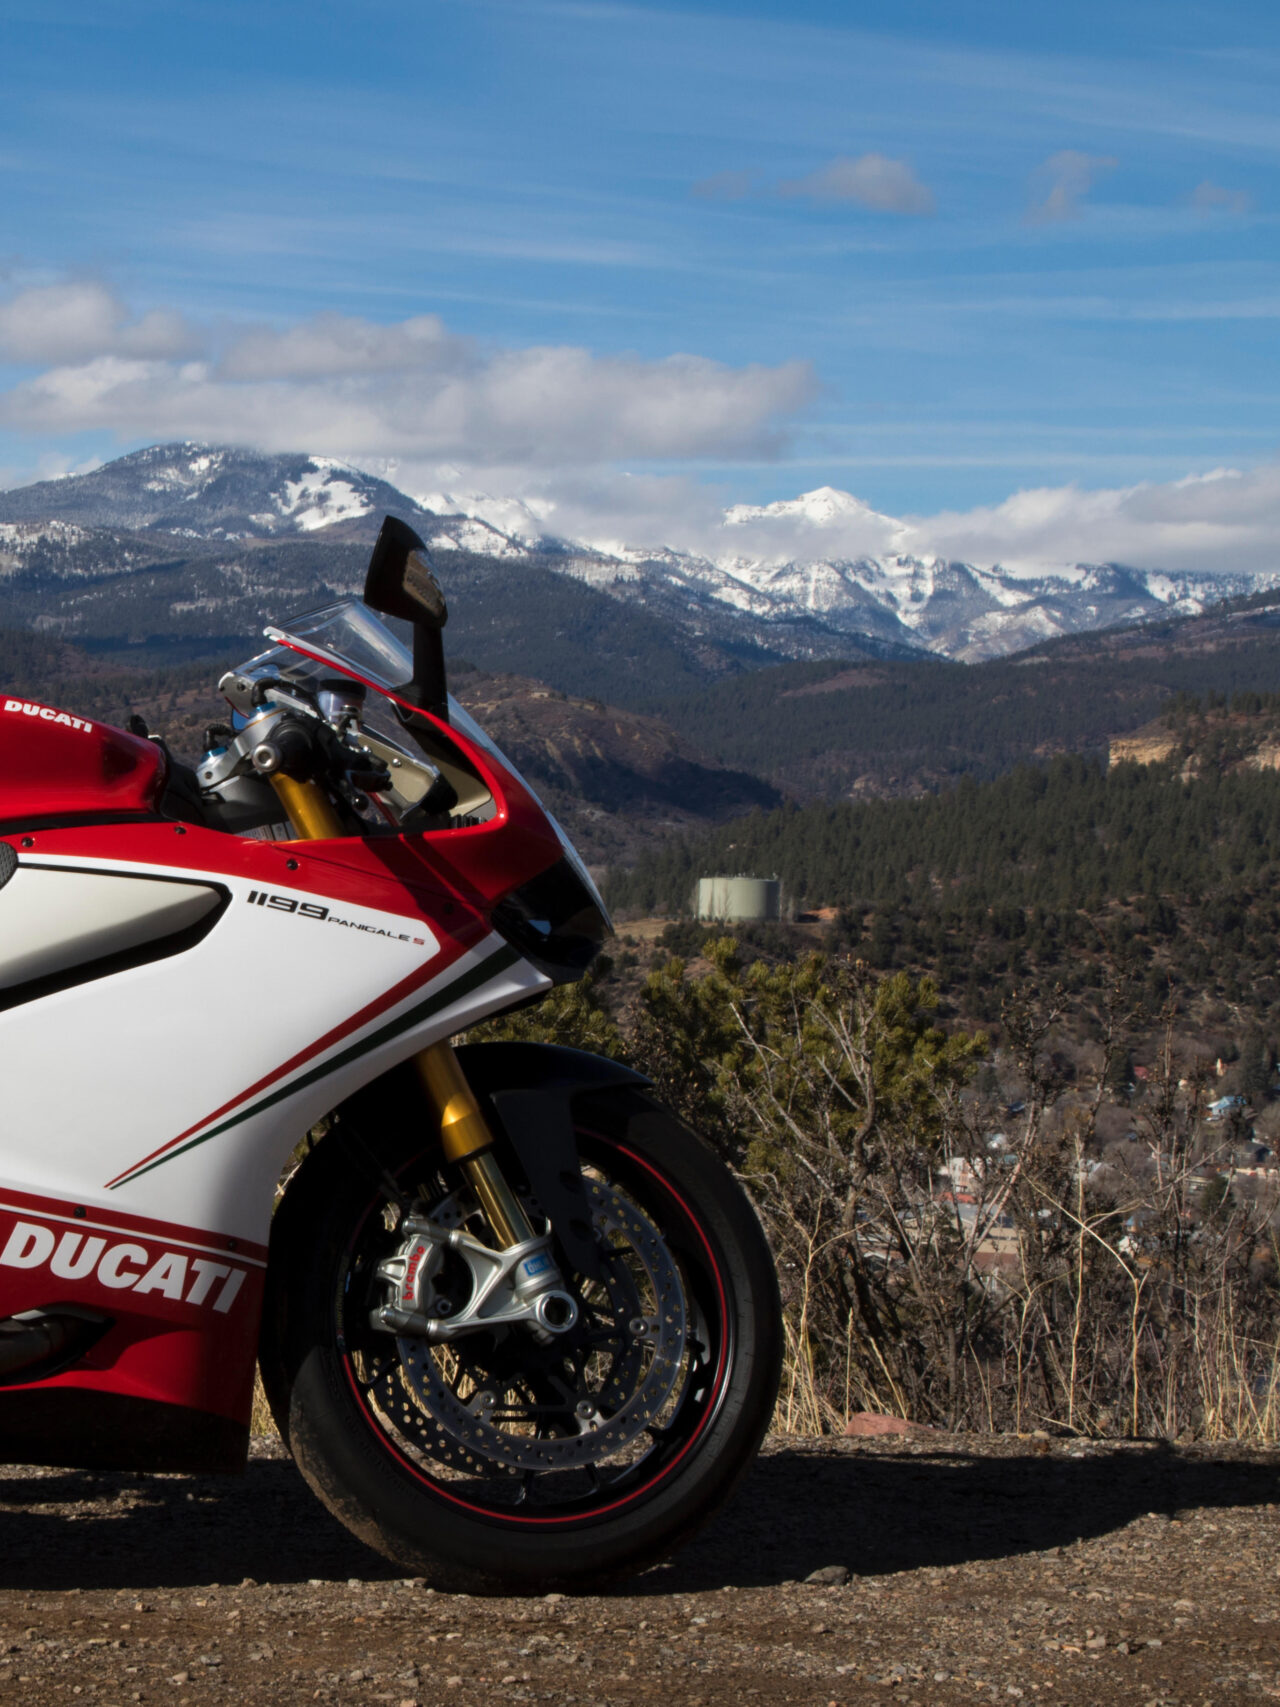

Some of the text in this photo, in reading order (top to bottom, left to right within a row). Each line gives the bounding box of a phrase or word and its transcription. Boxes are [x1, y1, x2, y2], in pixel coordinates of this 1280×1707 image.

[4, 700, 93, 733] DUCATI
[247, 890, 329, 921] 1199
[327, 917, 410, 942] PANIGALE
[402, 1245, 425, 1300] brembo
